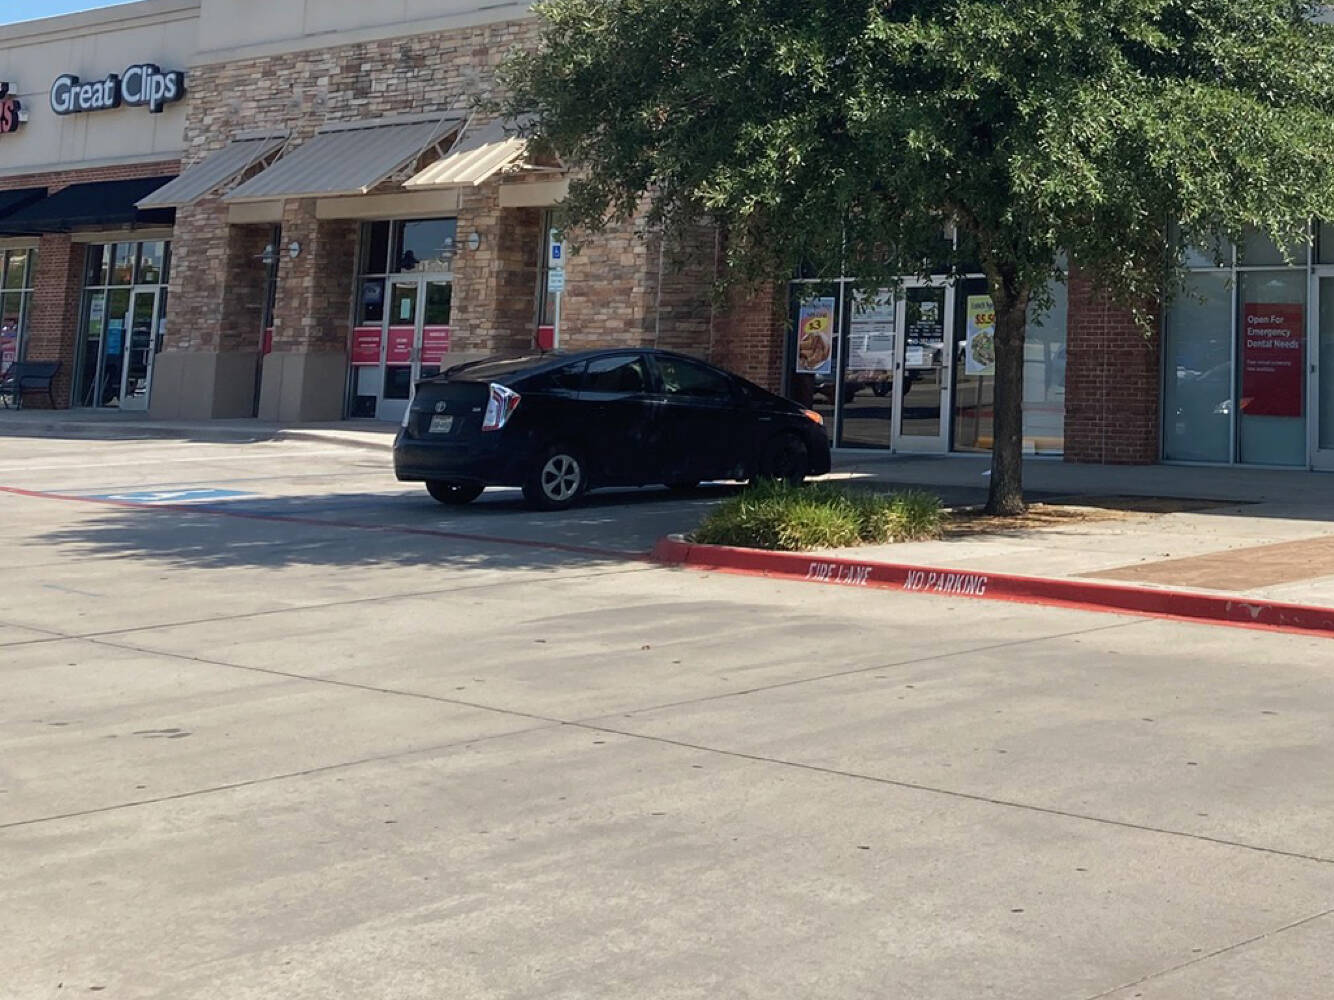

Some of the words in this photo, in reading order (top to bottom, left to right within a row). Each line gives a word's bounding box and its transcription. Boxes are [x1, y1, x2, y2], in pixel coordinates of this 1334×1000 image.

[51, 73, 121, 115] Great
[121, 63, 185, 113] Clips
[1247, 315, 1269, 325] Open
[1270, 315, 1284, 323] For
[1247, 327, 1290, 338] Emergency
[1247, 339, 1272, 348] Dental
[1274, 340, 1299, 349] Needs
[804, 562, 834, 583] FIRE
[836, 563, 872, 585] LANE
[903, 570, 924, 590] NO
[923, 572, 987, 596] PARKING
